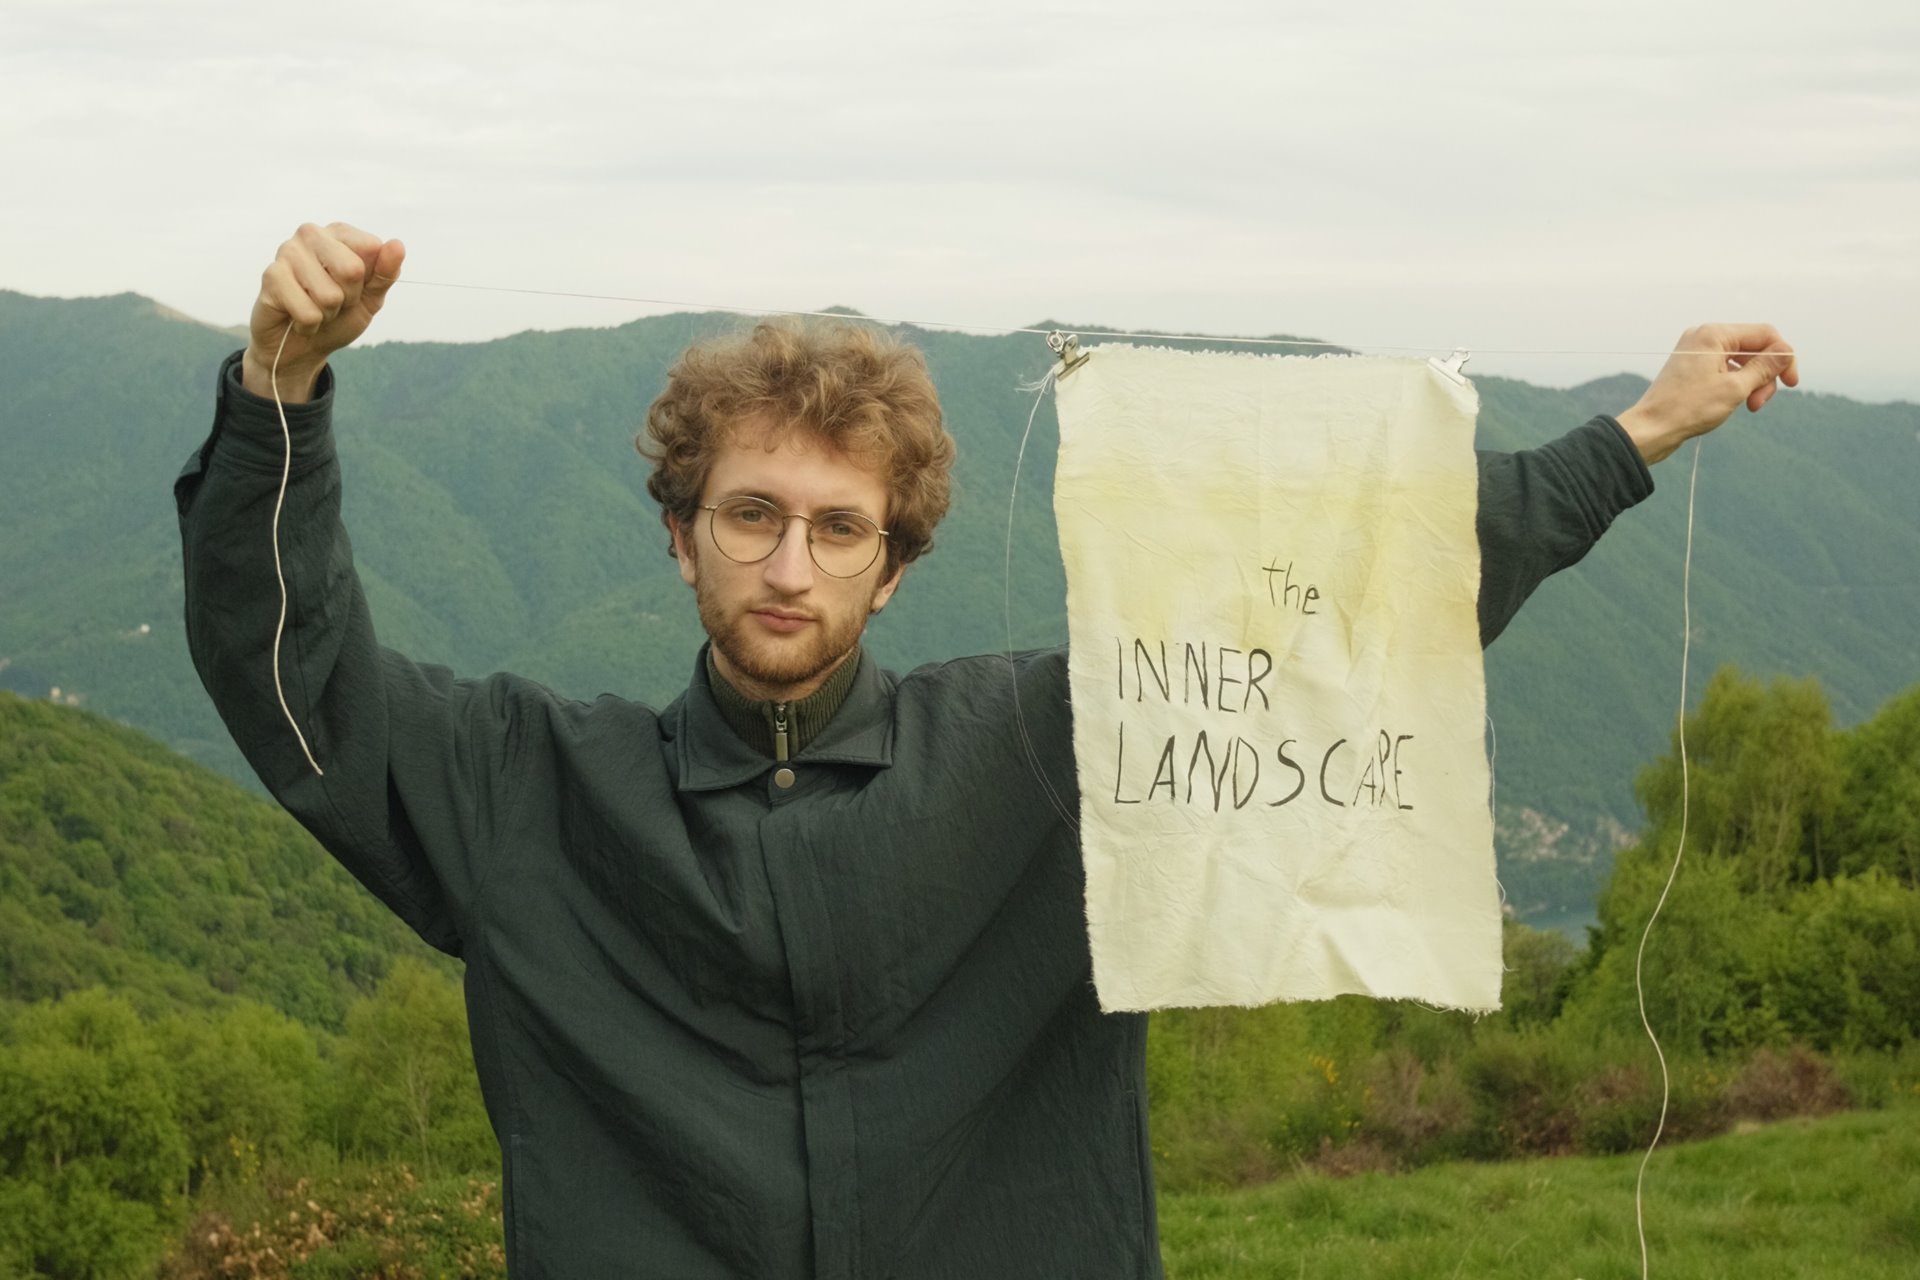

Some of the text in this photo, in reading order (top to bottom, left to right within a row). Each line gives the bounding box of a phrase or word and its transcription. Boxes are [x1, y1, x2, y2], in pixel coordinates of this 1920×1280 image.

[1262, 557, 1320, 615] the
[1115, 637, 1272, 712] INNER
[1114, 721, 1414, 813] LANDSCAPE
